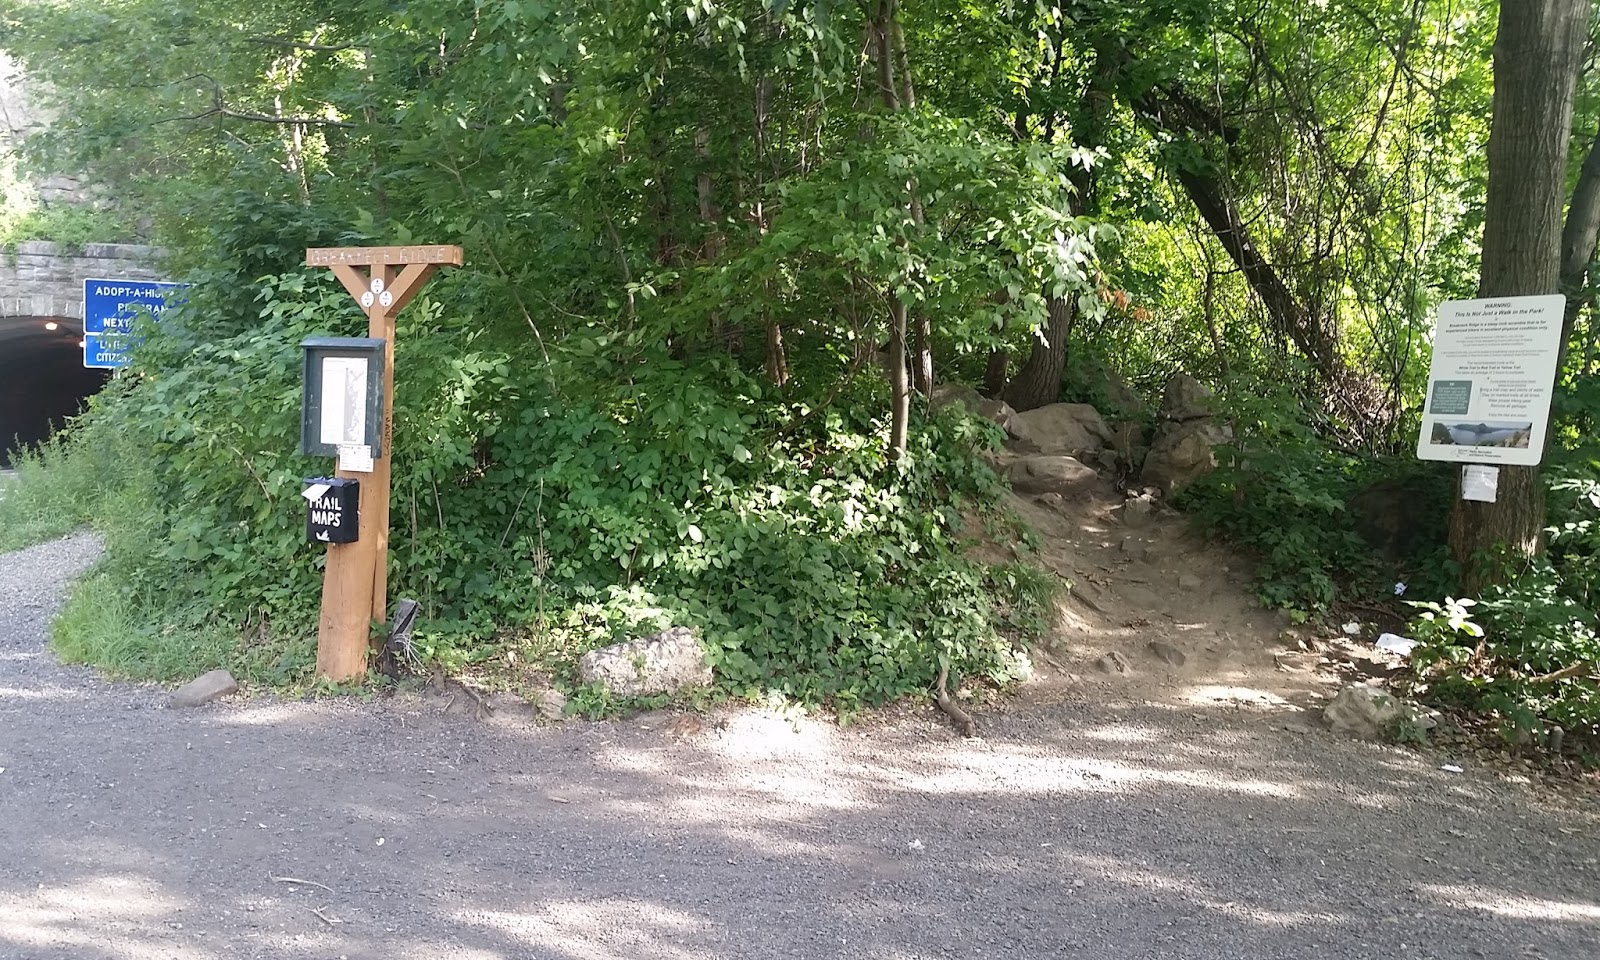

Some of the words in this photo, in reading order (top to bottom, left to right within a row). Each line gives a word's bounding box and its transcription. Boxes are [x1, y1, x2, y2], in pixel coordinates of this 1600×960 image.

[399, 248, 445, 263] RIDGE
[95, 286, 165, 298] ADOPT-A-HI
[103, 318, 129, 328] NEXT
[312, 510, 342, 527] MAPS
